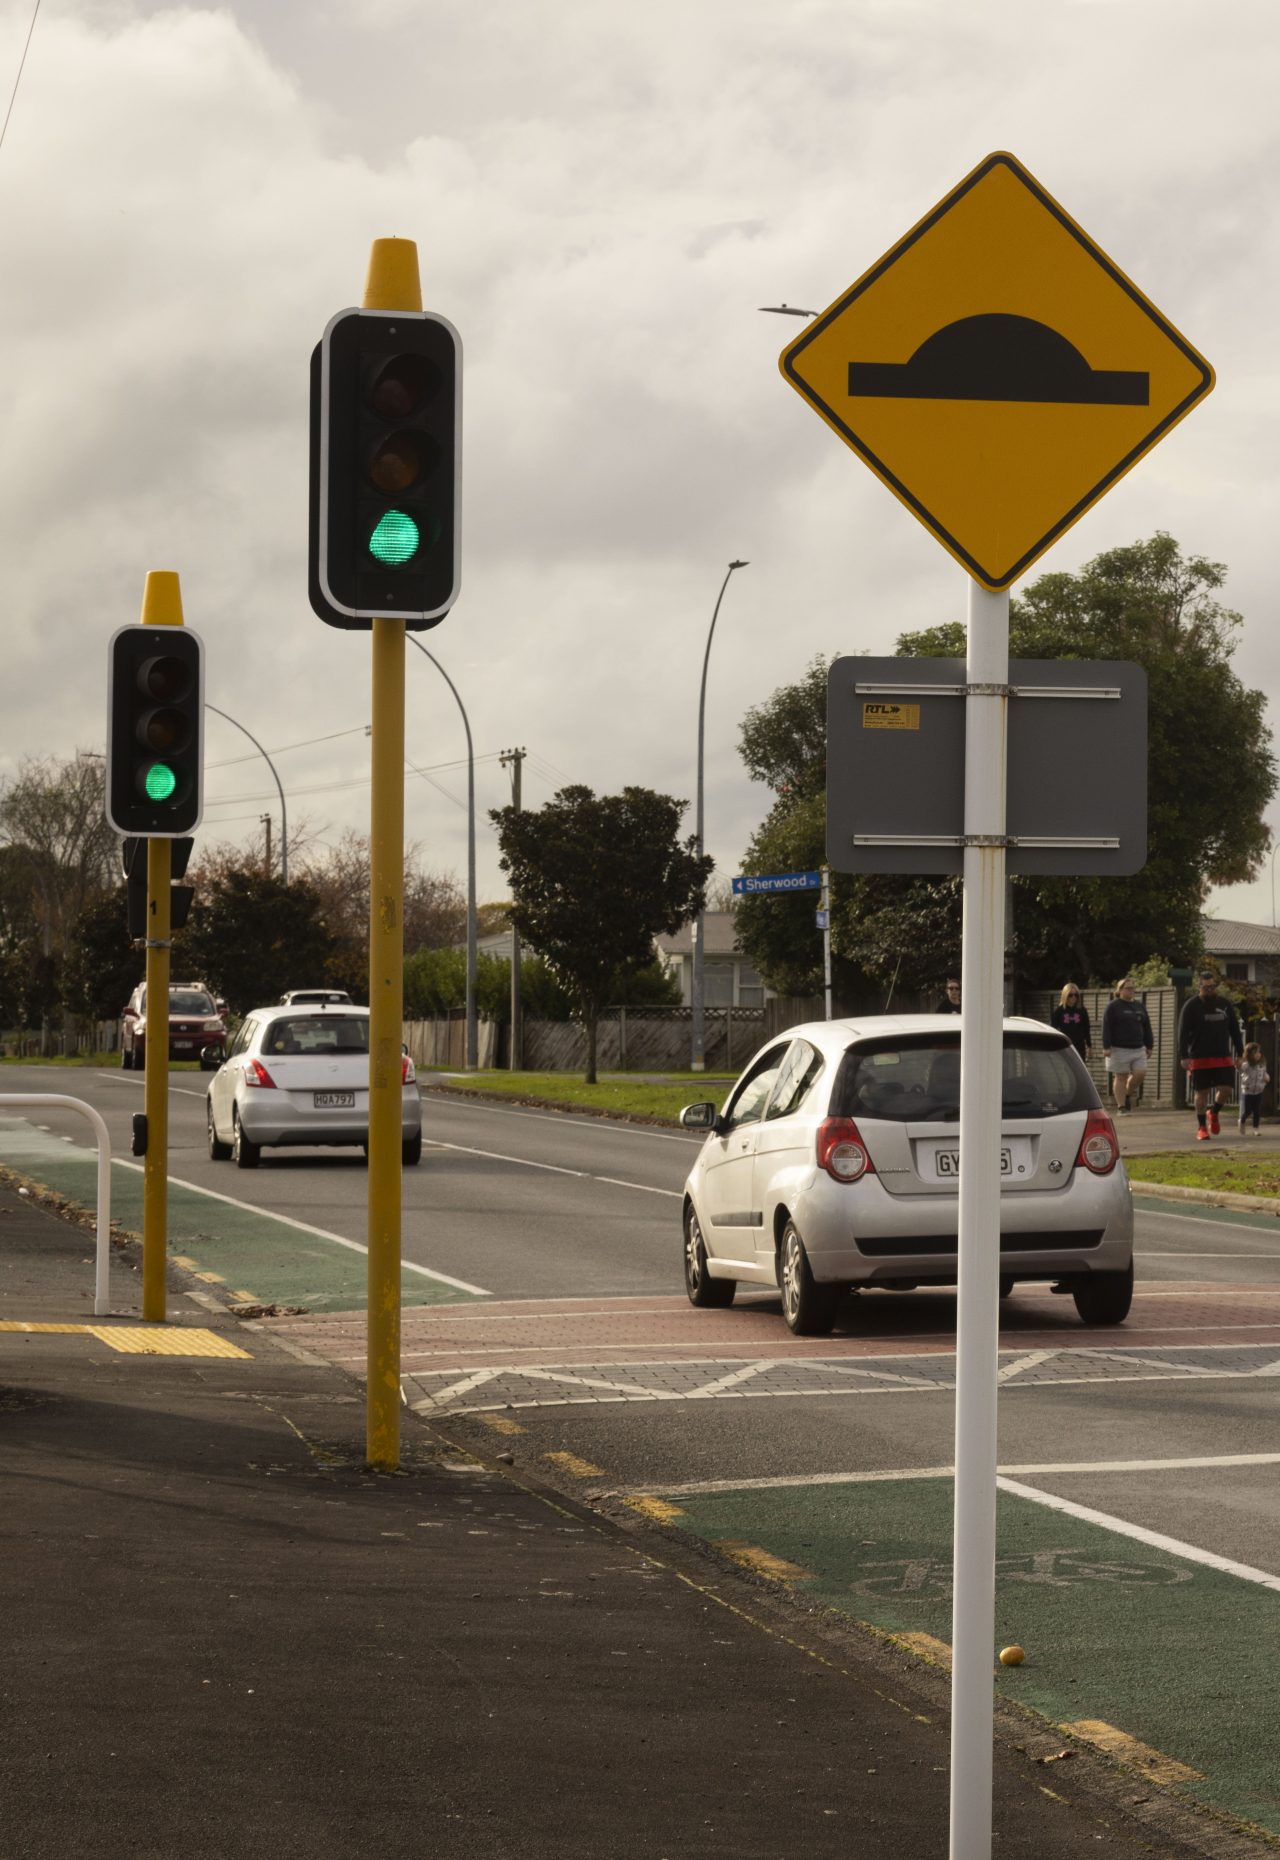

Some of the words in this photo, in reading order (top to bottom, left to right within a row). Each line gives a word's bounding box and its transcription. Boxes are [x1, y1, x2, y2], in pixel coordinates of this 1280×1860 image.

[865, 704, 890, 714] RTL
[746, 875, 807, 891] Sherwood
[150, 900, 157, 915] 1
[316, 1094, 353, 1105] HQA797
